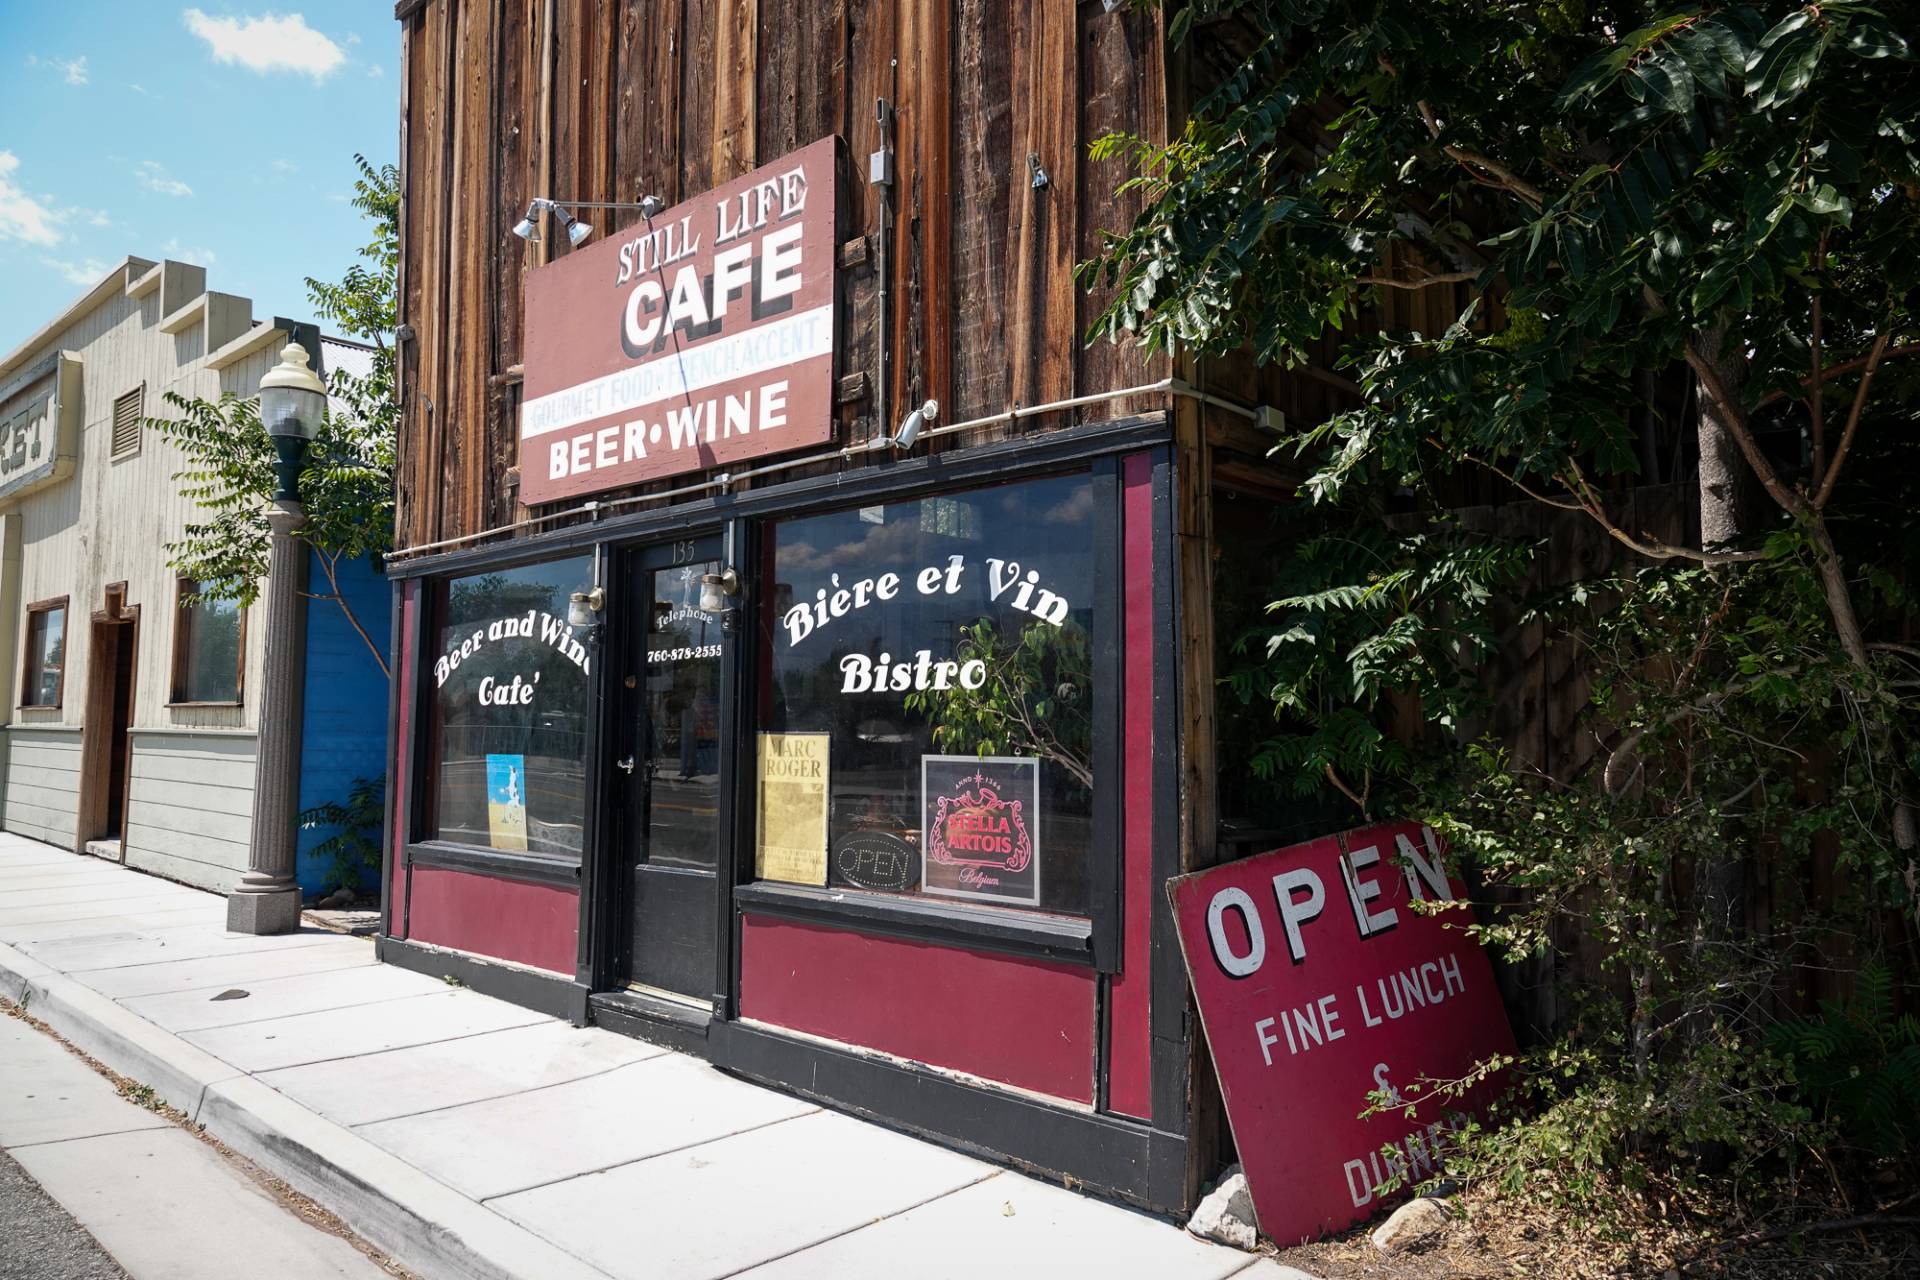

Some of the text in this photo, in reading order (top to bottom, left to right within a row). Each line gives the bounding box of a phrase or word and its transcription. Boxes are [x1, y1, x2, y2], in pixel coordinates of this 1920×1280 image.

[617, 164, 808, 286] STILL LIFE
[624, 221, 804, 347] CAFE
[531, 383, 605, 429] GOURMET
[610, 368, 654, 407] FOOD
[742, 316, 821, 364] ACCENT
[549, 380, 789, 480] BEER WINE
[672, 541, 695, 565] 135
[656, 605, 713, 629] Telephone
[783, 554, 1069, 647] Bière et Vin
[434, 630, 483, 688] Beer
[488, 609, 536, 641] and
[647, 644, 722, 663] 760-878-2555
[839, 649, 987, 694] Bistro
[769, 740, 816, 757] MARC
[766, 759, 822, 778] ROGER
[955, 776, 972, 790] ANNO
[946, 813, 1011, 834] STELLA
[946, 831, 1012, 854] ARTOIS
[838, 847, 909, 882] OPEN
[958, 867, 999, 888] Belgium
[1207, 826, 1453, 977] OPEN
[1256, 952, 1466, 1067] FINE LUNCH
